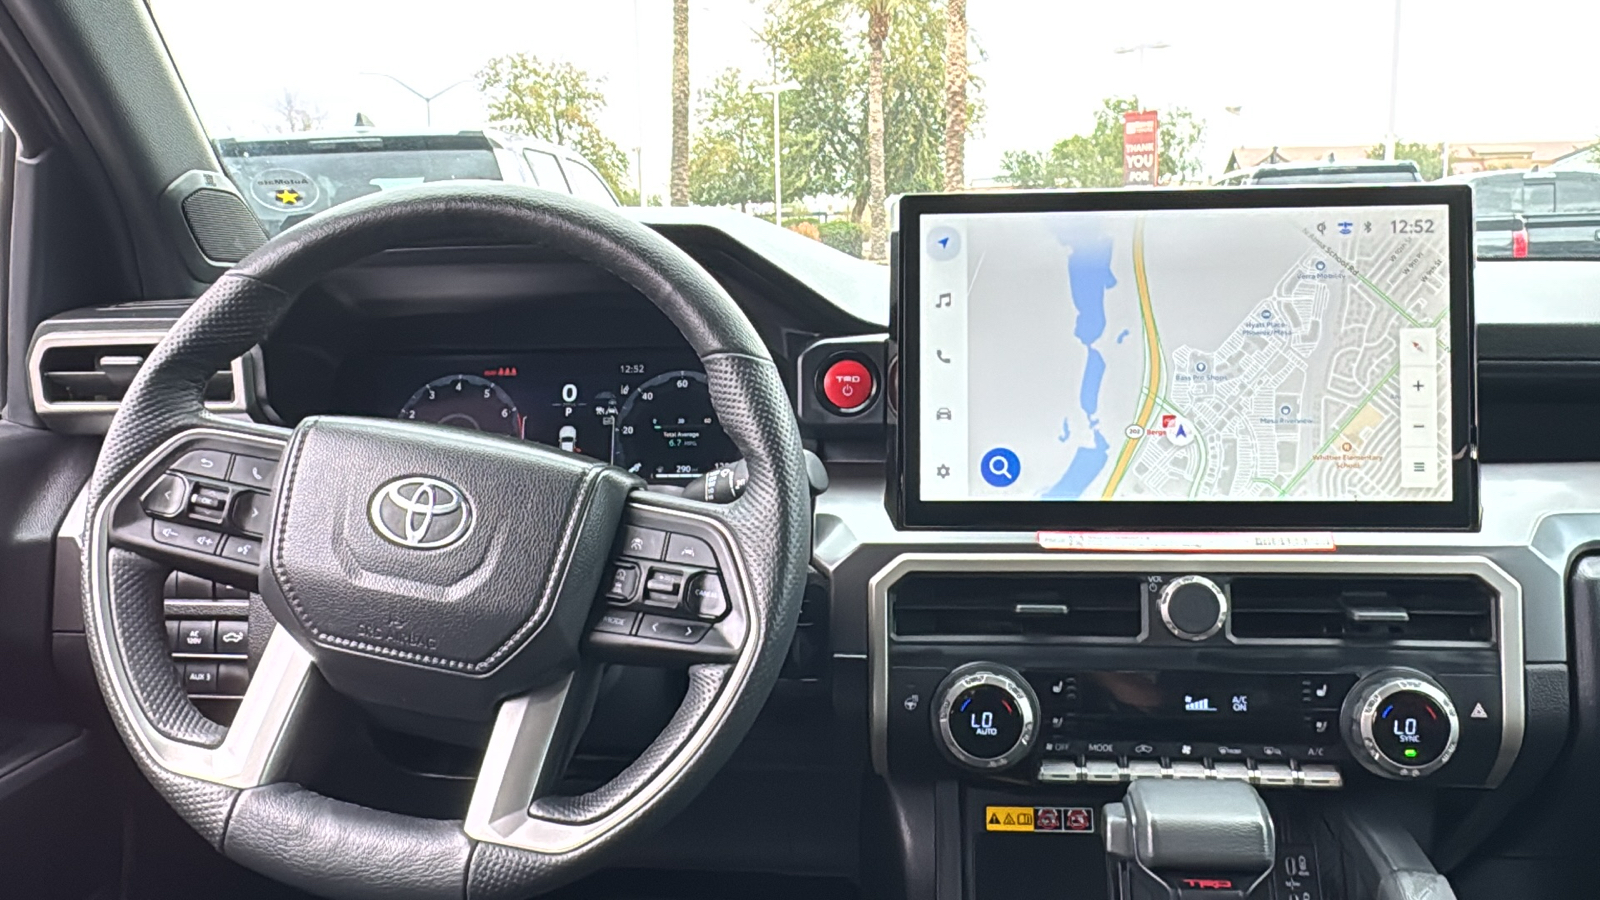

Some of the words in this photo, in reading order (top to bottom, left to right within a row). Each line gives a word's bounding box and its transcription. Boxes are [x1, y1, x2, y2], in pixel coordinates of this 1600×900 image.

[1125, 142, 1154, 153] THANK
[1126, 153, 1154, 169] YOU
[1391, 219, 1434, 234] 12:52
[1325, 246, 1349, 268] School
[1347, 265, 1359, 276] Rd
[620, 364, 645, 374] 12:52
[835, 375, 861, 383] TRD
[455, 382, 463, 391] 4
[676, 379, 689, 389] 60
[429, 390, 436, 400] 3
[484, 389, 491, 399] 5
[561, 383, 578, 402] 0
[641, 392, 654, 401] 40
[408, 410, 416, 419] 2
[501, 408, 509, 418] 6
[565, 407, 573, 417] P
[622, 426, 635, 435] 20
[677, 431, 700, 439] Average
[676, 465, 692, 474] 290
[1148, 575, 1162, 583] VOL
[189, 672, 205, 681] AUX
[1232, 695, 1248, 704] A/C
[1232, 703, 1248, 712] ON
[971, 711, 993, 728] LO
[1393, 718, 1417, 735] LO
[976, 728, 998, 736] AUTO
[1399, 735, 1420, 743] SYNC
[1088, 743, 1114, 752] MODE
[1307, 747, 1325, 756] A/C
